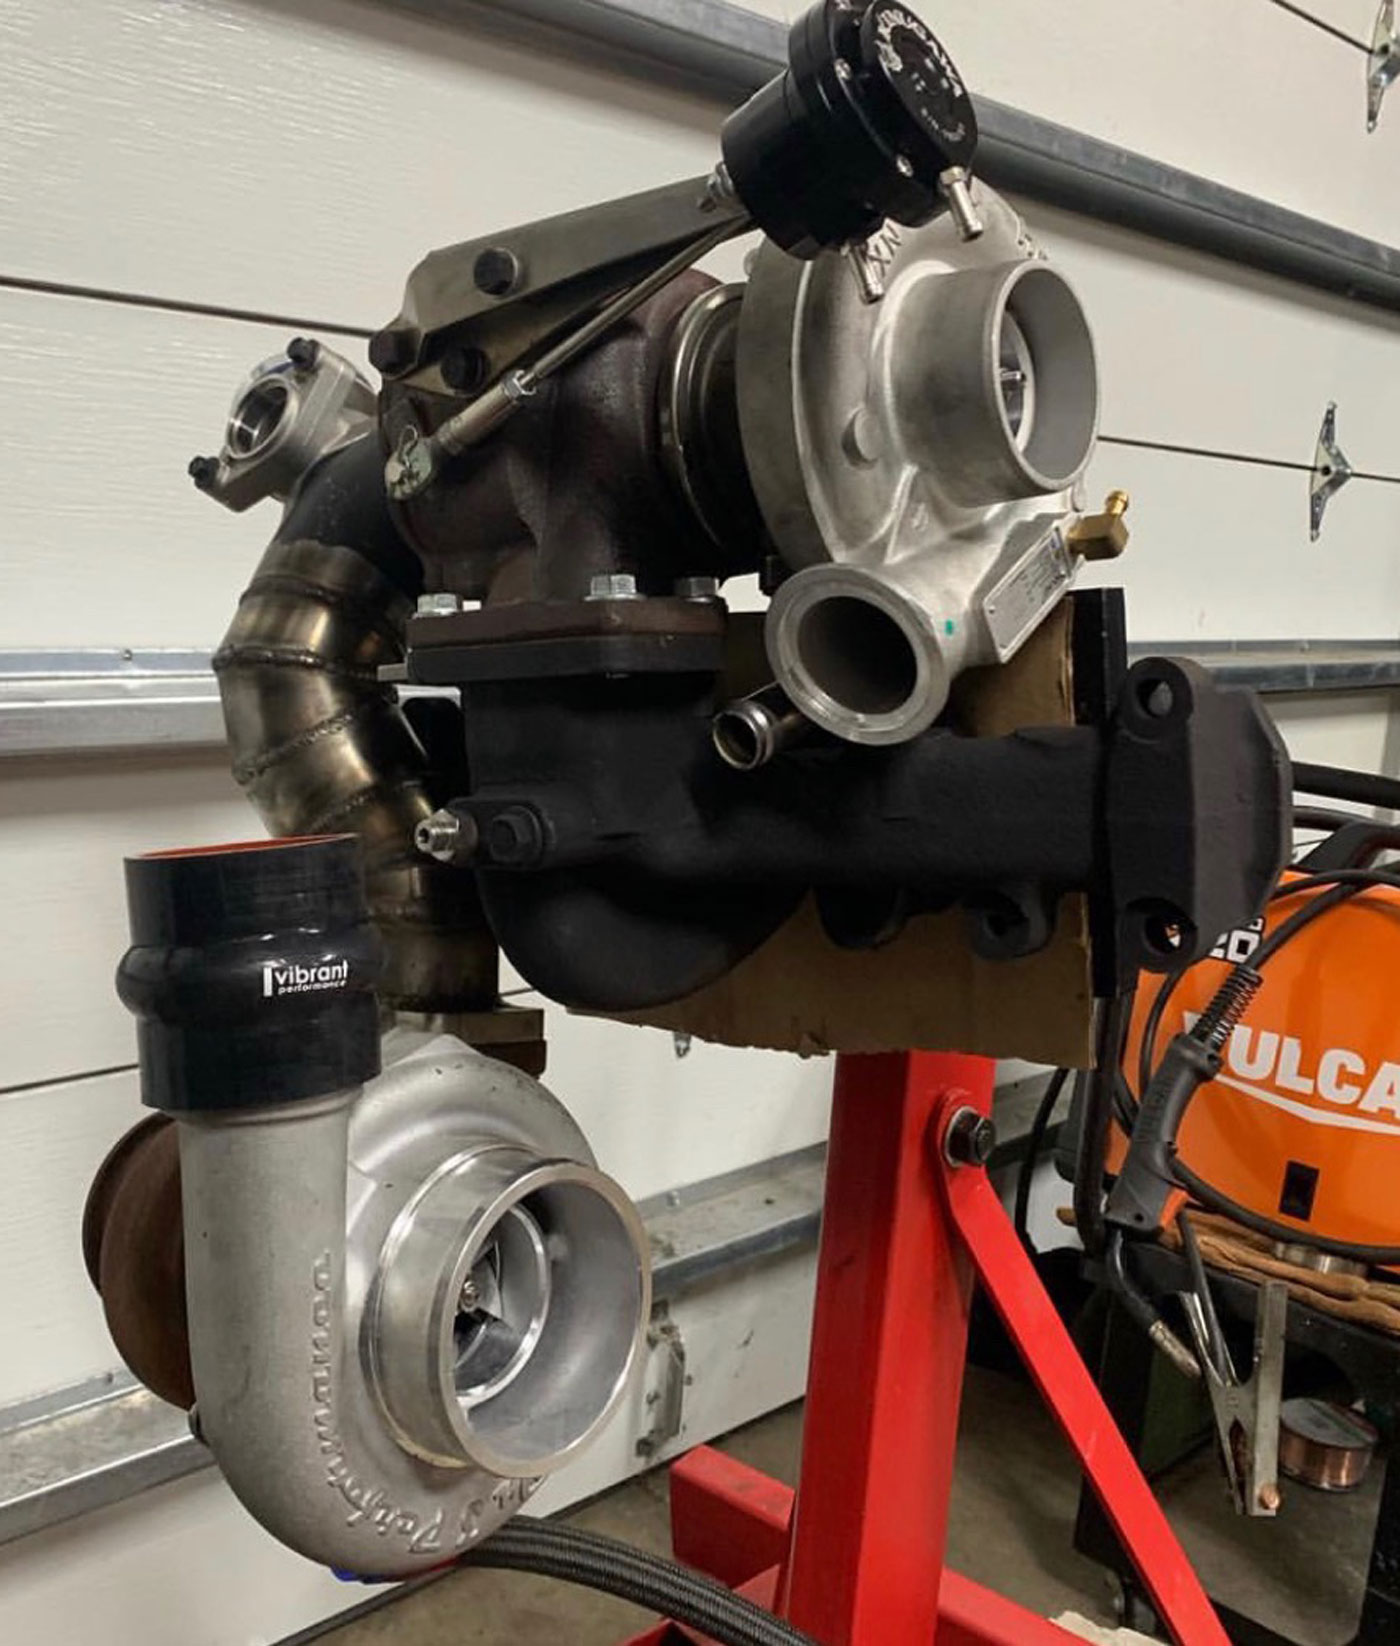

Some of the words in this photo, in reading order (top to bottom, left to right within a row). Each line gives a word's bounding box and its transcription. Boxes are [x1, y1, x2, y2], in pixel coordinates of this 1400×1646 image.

[274, 959, 349, 984] vibrant
[278, 980, 346, 995] performance
[1183, 1011, 1400, 1119] ULCA
